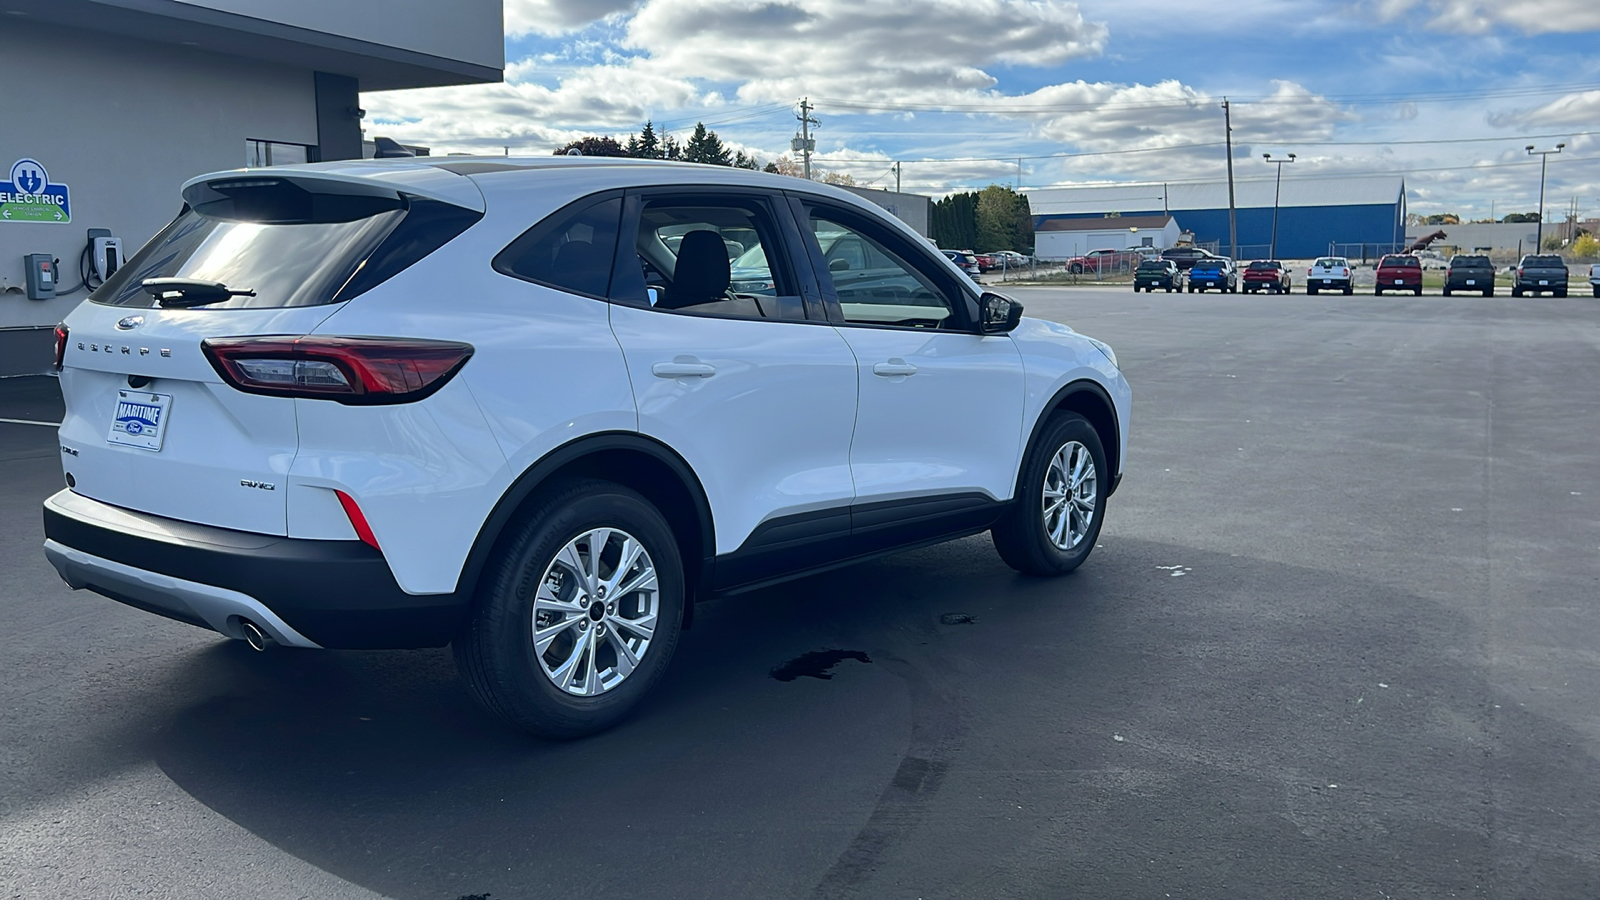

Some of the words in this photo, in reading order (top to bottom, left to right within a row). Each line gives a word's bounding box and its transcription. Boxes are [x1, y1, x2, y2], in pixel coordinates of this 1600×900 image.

[0, 192, 64, 205] ELECTRIC
[78, 343, 171, 357] ESCAPE
[117, 403, 160, 424] MARITIME
[128, 422, 141, 433] Ford
[241, 479, 275, 491] AWD
